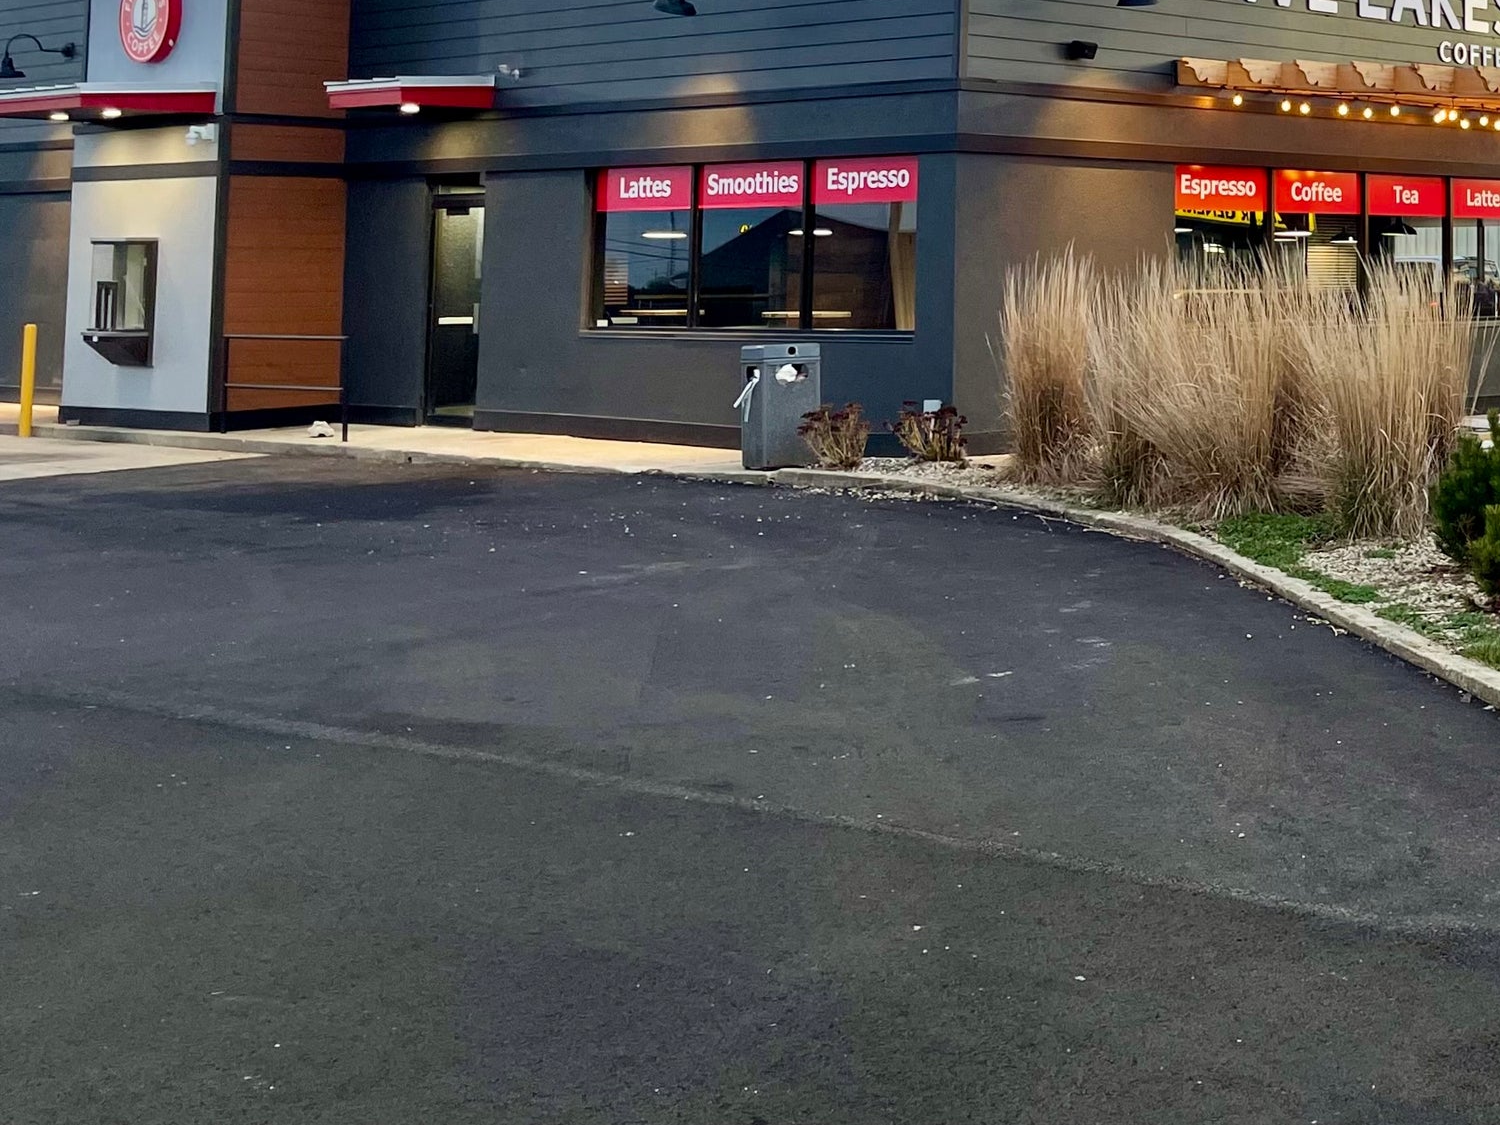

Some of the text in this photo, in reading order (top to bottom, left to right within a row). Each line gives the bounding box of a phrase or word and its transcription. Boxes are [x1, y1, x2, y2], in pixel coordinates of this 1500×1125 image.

[127, 31, 160, 54] COFFEE
[619, 177, 672, 199] Lattes
[707, 170, 799, 196] Smoothies
[826, 167, 910, 195] Espresso
[1180, 174, 1256, 200] Espresso
[1291, 181, 1343, 203] Coffee
[1393, 185, 1419, 205] Tea
